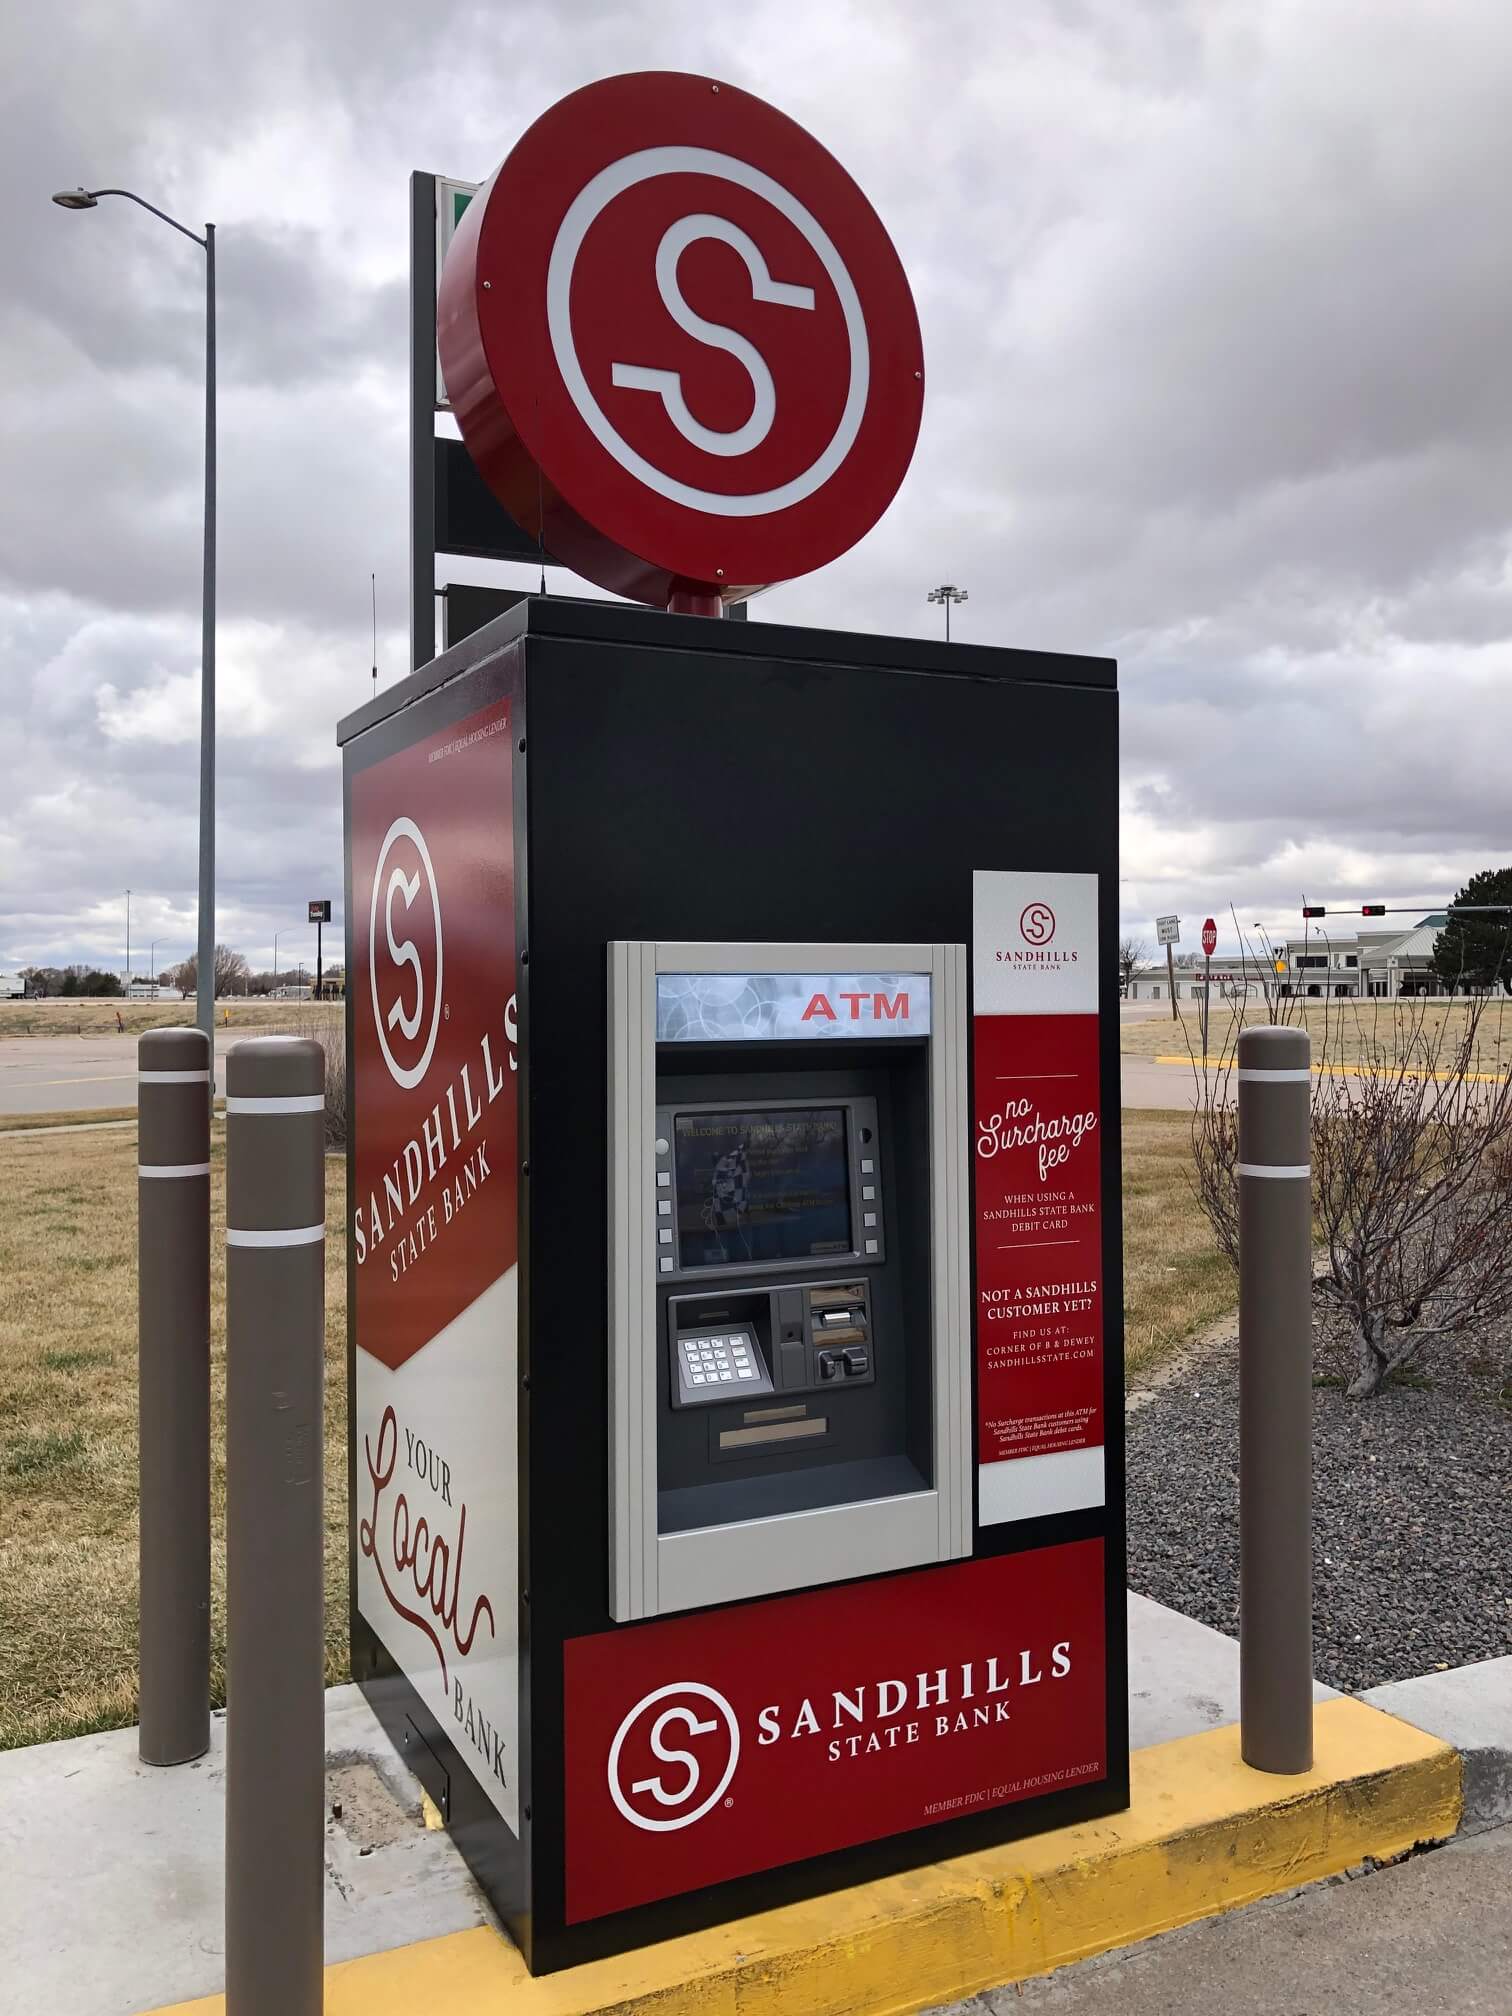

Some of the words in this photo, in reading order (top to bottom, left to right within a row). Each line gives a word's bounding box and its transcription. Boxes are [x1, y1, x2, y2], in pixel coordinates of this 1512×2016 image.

[1202, 930, 1216, 945] STOP
[996, 951, 1078, 962] SANDHILLS
[801, 993, 909, 1021] ATM
[1006, 1098, 1033, 1119] no
[354, 993, 518, 1265] SANDHILLS
[977, 1112, 1097, 1158] Surcharge
[1039, 1144, 1070, 1182] fee
[1004, 1193, 1034, 1204] WHEN
[1036, 1191, 1066, 1202] USING
[1068, 1191, 1075, 1200] A
[390, 1205, 438, 1282] STATE
[442, 1140, 491, 1224] BANK
[983, 1207, 1037, 1220] SANDHILLS
[1039, 1205, 1068, 1216] STATE
[1070, 1203, 1095, 1214] BANK
[1012, 1221, 1041, 1232] DEBIT
[1042, 1219, 1068, 1230] CARD
[981, 1289, 1011, 1303] NOT
[1014, 1288, 1022, 1300] A
[1025, 1280, 1097, 1298] SANDHILLS
[987, 1302, 1060, 1320] CUSTOMER
[1063, 1298, 1093, 1312] YET?
[1013, 1329, 1036, 1339] FIND
[1040, 1327, 1051, 1336] US
[1055, 1325, 1070, 1335] AT:
[986, 1344, 1026, 1356] CORNER
[1029, 1342, 1042, 1351] OF
[1045, 1341, 1051, 1349] B
[1054, 1340, 1060, 1348] &
[1063, 1336, 1095, 1347] DEWEY
[987, 1349, 1094, 1370] SANDHILLSSTATE.COM
[1018, 1424, 1033, 1432] State
[1033, 1422, 1047, 1430] Bank
[1024, 1430, 1039, 1438] State
[1039, 1428, 1053, 1436] Bank
[405, 1428, 453, 1507] YOUR
[360, 1405, 495, 1695] Local
[758, 1641, 1072, 1746] SANDHILLS
[454, 1675, 507, 1789] BANK
[828, 1722, 920, 1762] STATE
[935, 1701, 1011, 1737] BANK
[923, 1797, 963, 1816] MEMBER
[964, 1790, 986, 1806] FDIC
[992, 1781, 1022, 1798] EQUAL
[1023, 1769, 1065, 1791] HOUSING
[1065, 1761, 1100, 1778] LENDER
